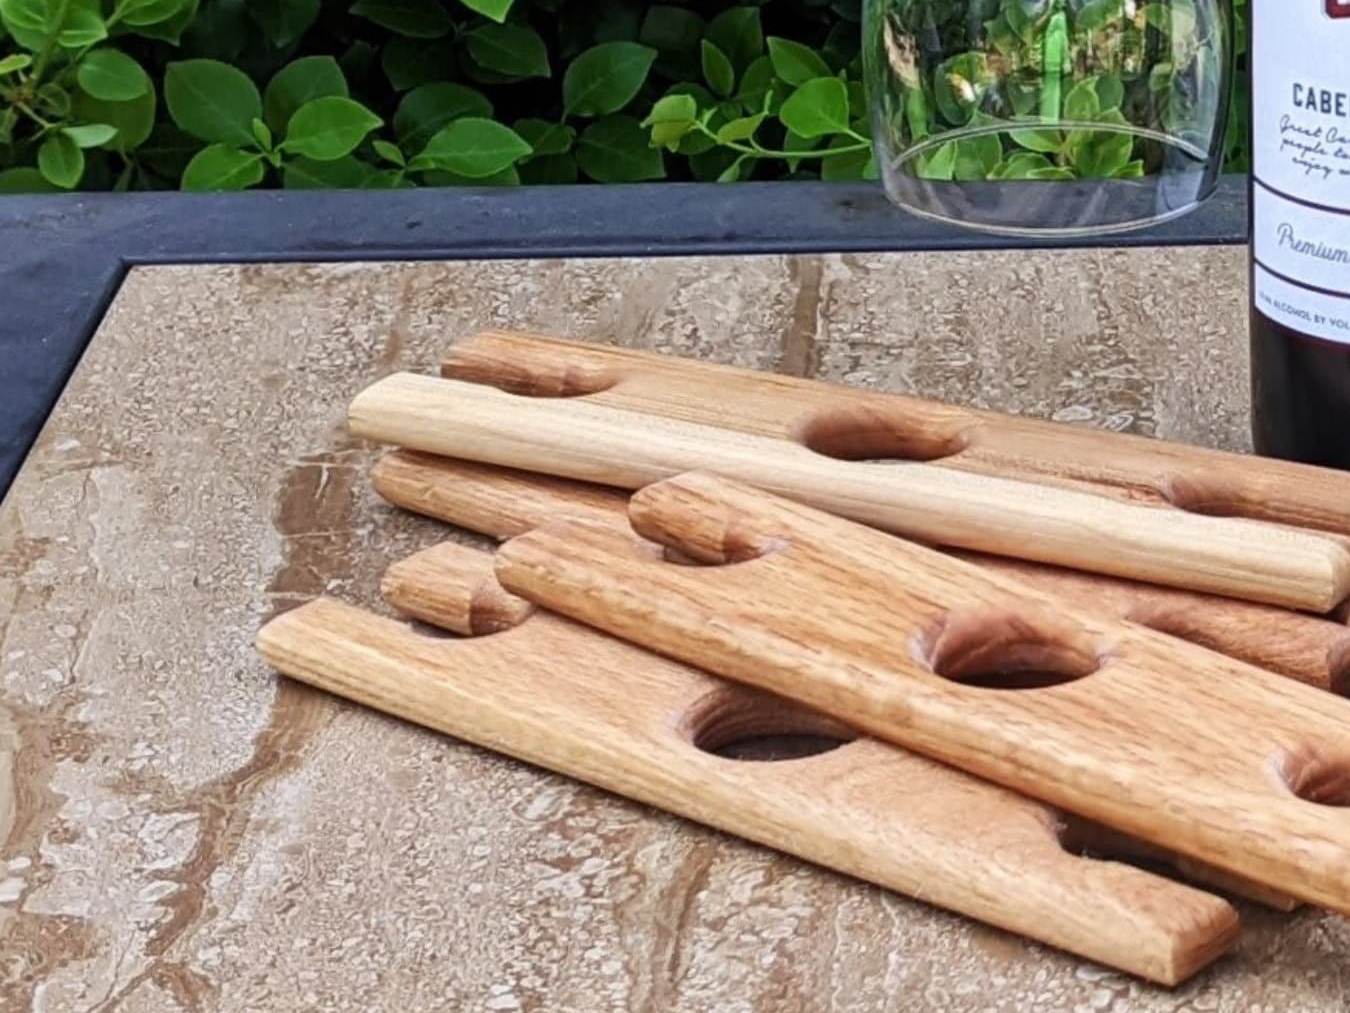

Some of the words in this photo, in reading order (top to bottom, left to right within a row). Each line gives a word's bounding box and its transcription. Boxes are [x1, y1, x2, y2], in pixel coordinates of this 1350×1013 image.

[1279, 114, 1322, 139] Great
[1280, 138, 1328, 158] people
[1292, 157, 1332, 180] enjoy
[1277, 222, 1350, 264] Premium
[1273, 300, 1313, 322] ALCOHOL
[1314, 314, 1327, 325] BY
